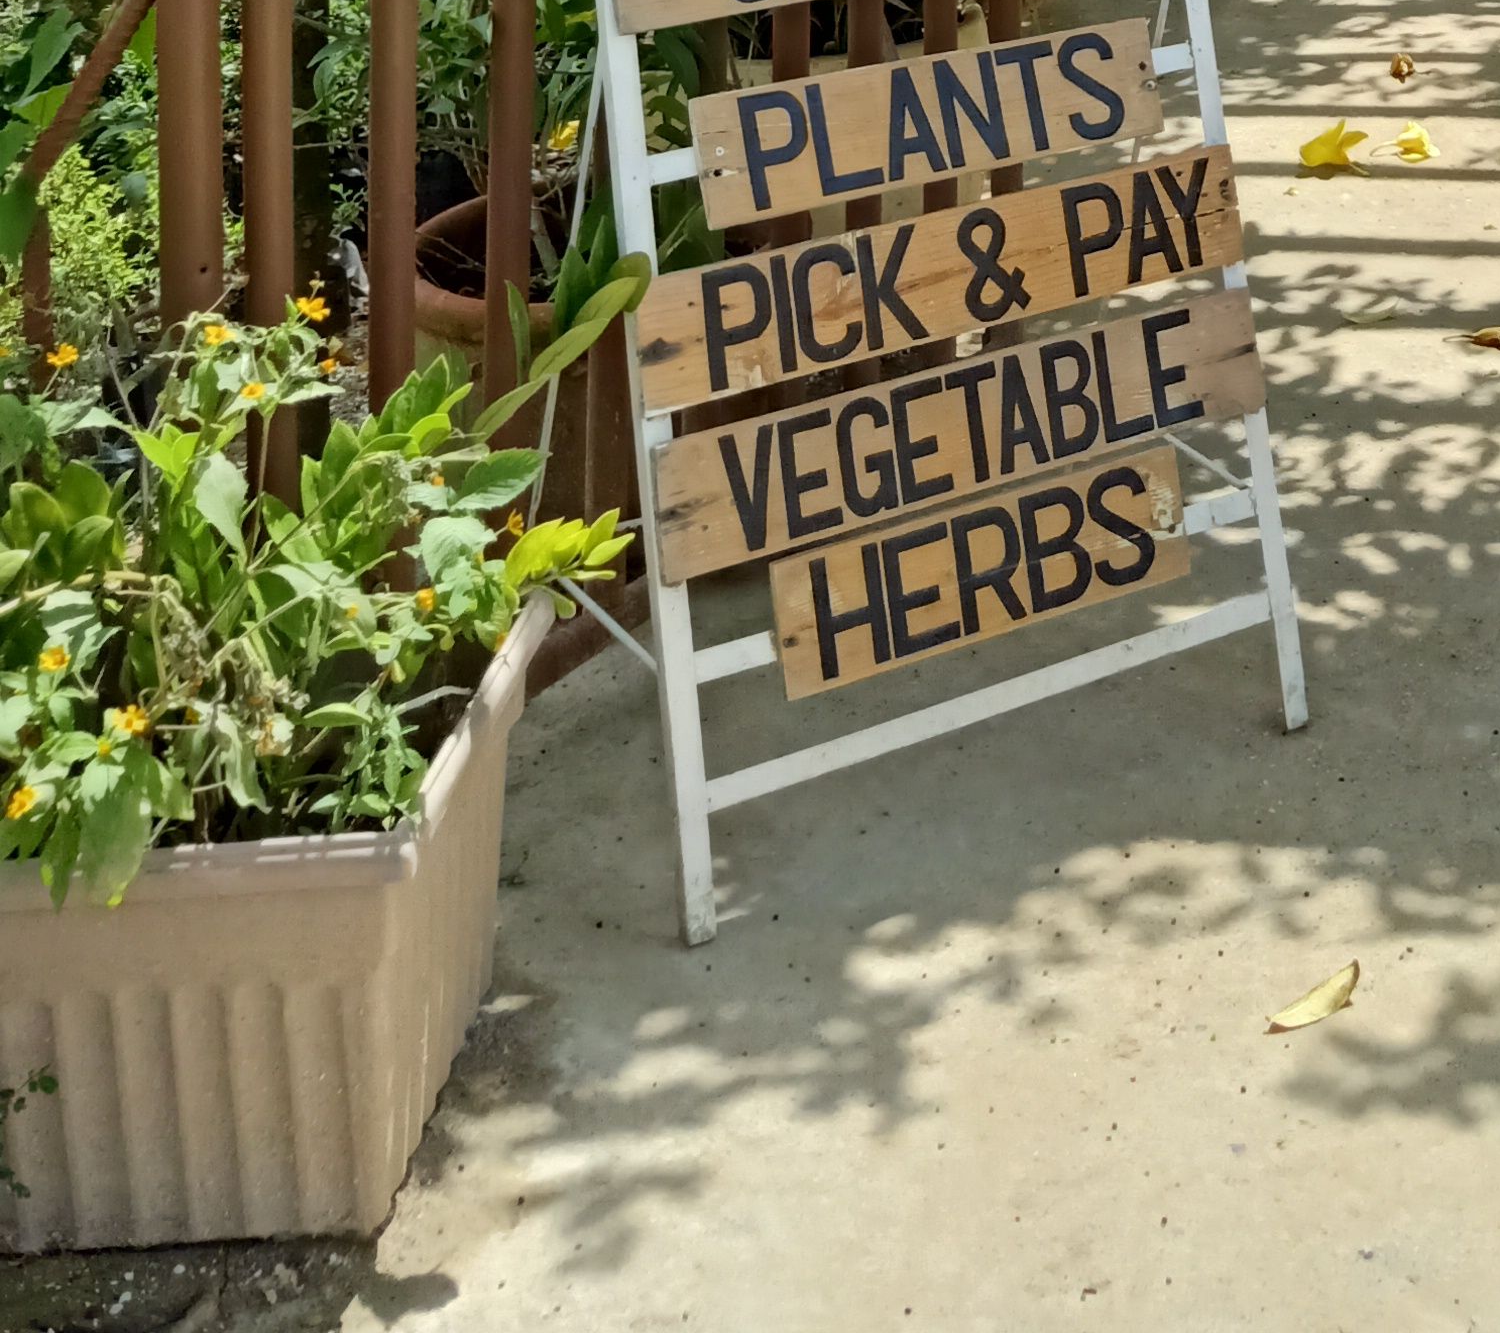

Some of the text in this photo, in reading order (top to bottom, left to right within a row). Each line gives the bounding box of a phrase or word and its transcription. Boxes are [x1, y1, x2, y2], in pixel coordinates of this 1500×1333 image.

[737, 32, 1126, 211] PLANTS
[700, 157, 1210, 392] PICK & PAY
[718, 308, 1205, 551] VEGETABLE
[808, 466, 1157, 681] HERBS
